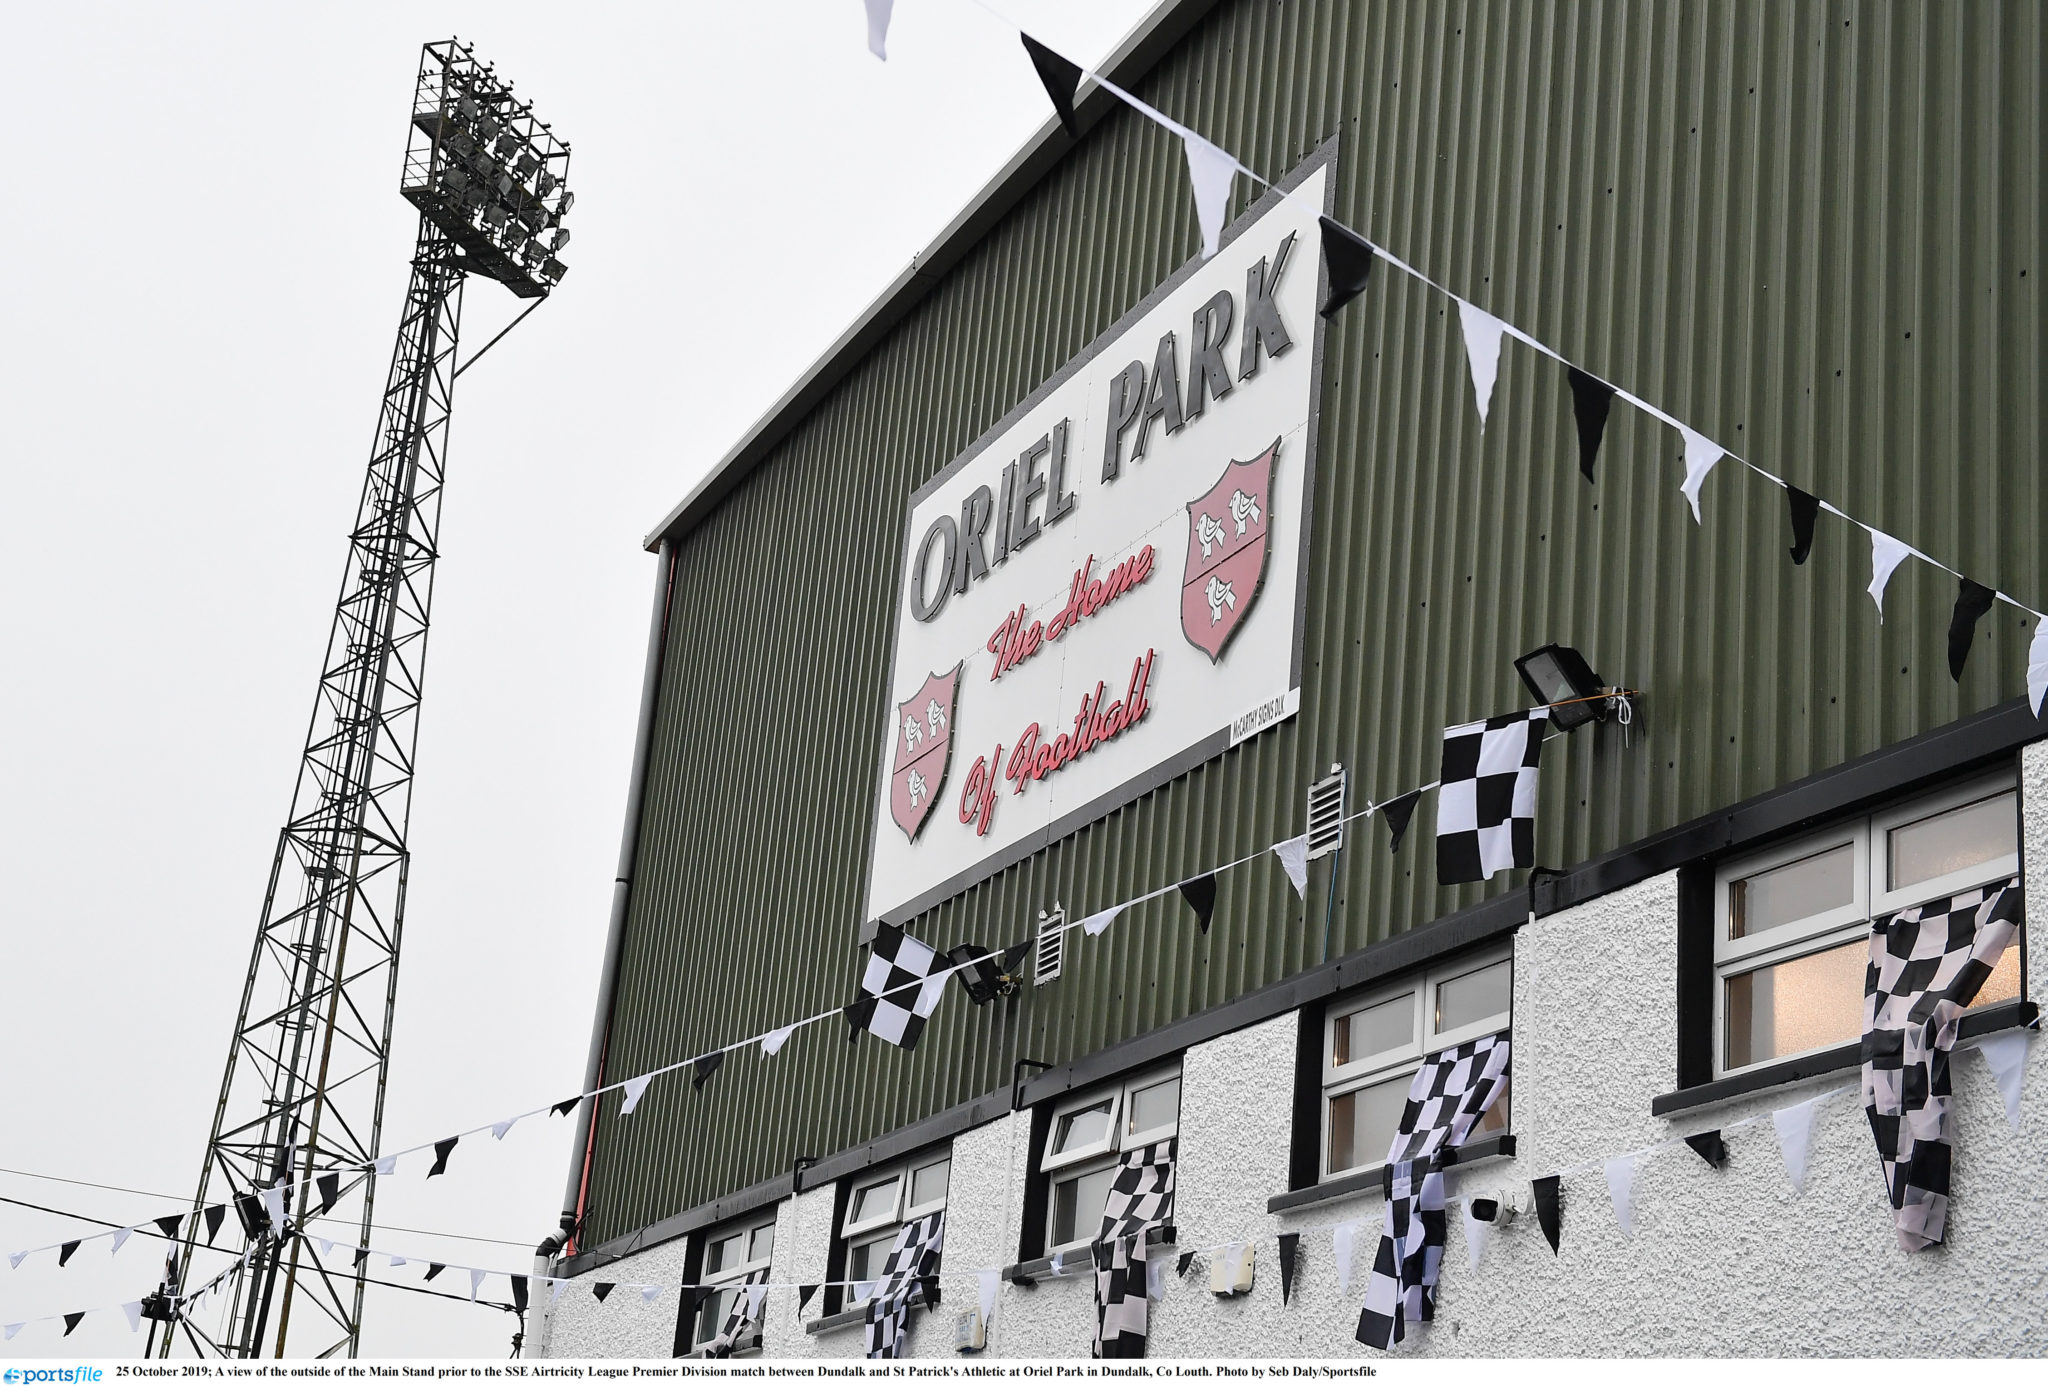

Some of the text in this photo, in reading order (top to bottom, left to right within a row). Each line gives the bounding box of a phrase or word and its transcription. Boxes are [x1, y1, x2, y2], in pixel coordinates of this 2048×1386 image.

[910, 229, 1297, 622] ORIEL PARK
[987, 544, 1154, 681] The Home
[959, 648, 1153, 836] Of Football
[1258, 699, 1274, 726] SIGNS
[1275, 694, 1285, 718] DLK
